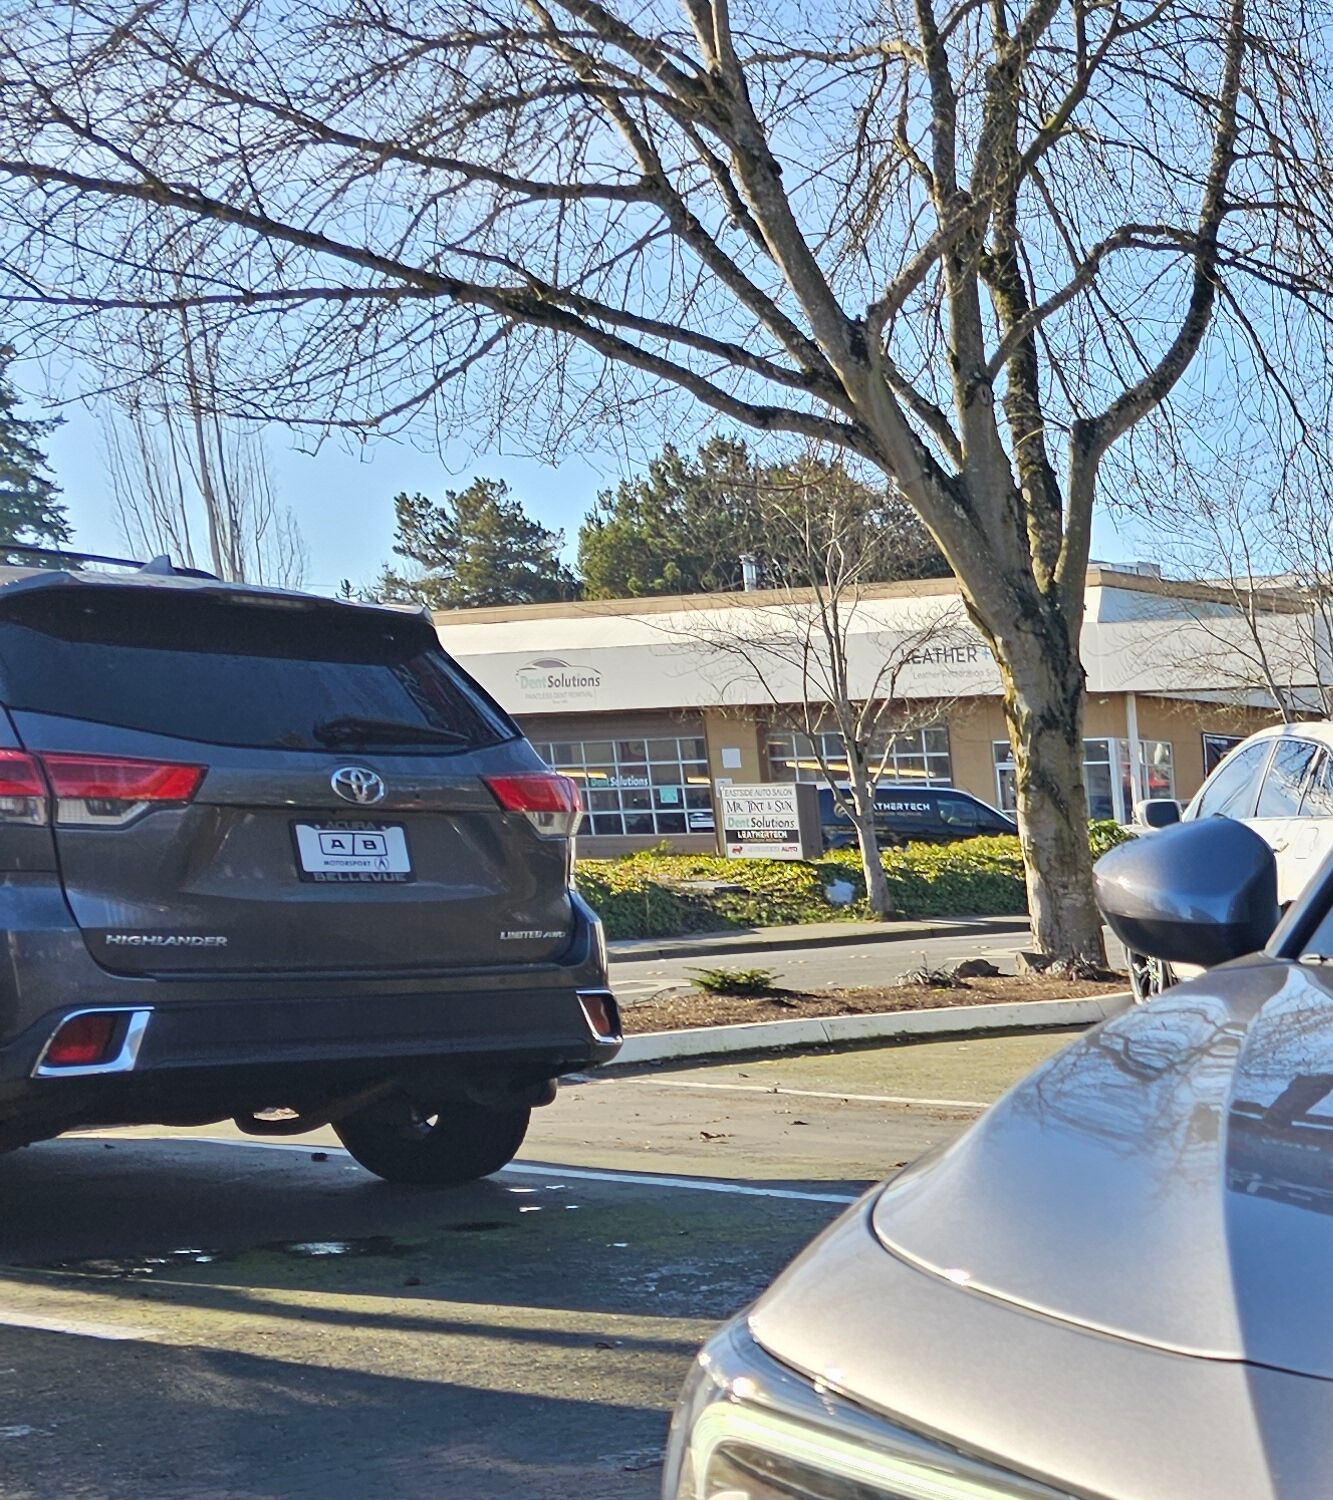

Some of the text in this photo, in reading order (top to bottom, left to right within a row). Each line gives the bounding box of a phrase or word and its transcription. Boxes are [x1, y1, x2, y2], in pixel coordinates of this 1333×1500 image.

[902, 646, 977, 664] LEATHER
[724, 787, 793, 797] EASTSIDE AUTO SALON
[325, 821, 376, 830] ACURA
[314, 872, 408, 882] BELLEVUE
[105, 934, 228, 947] HIGHLANDER
